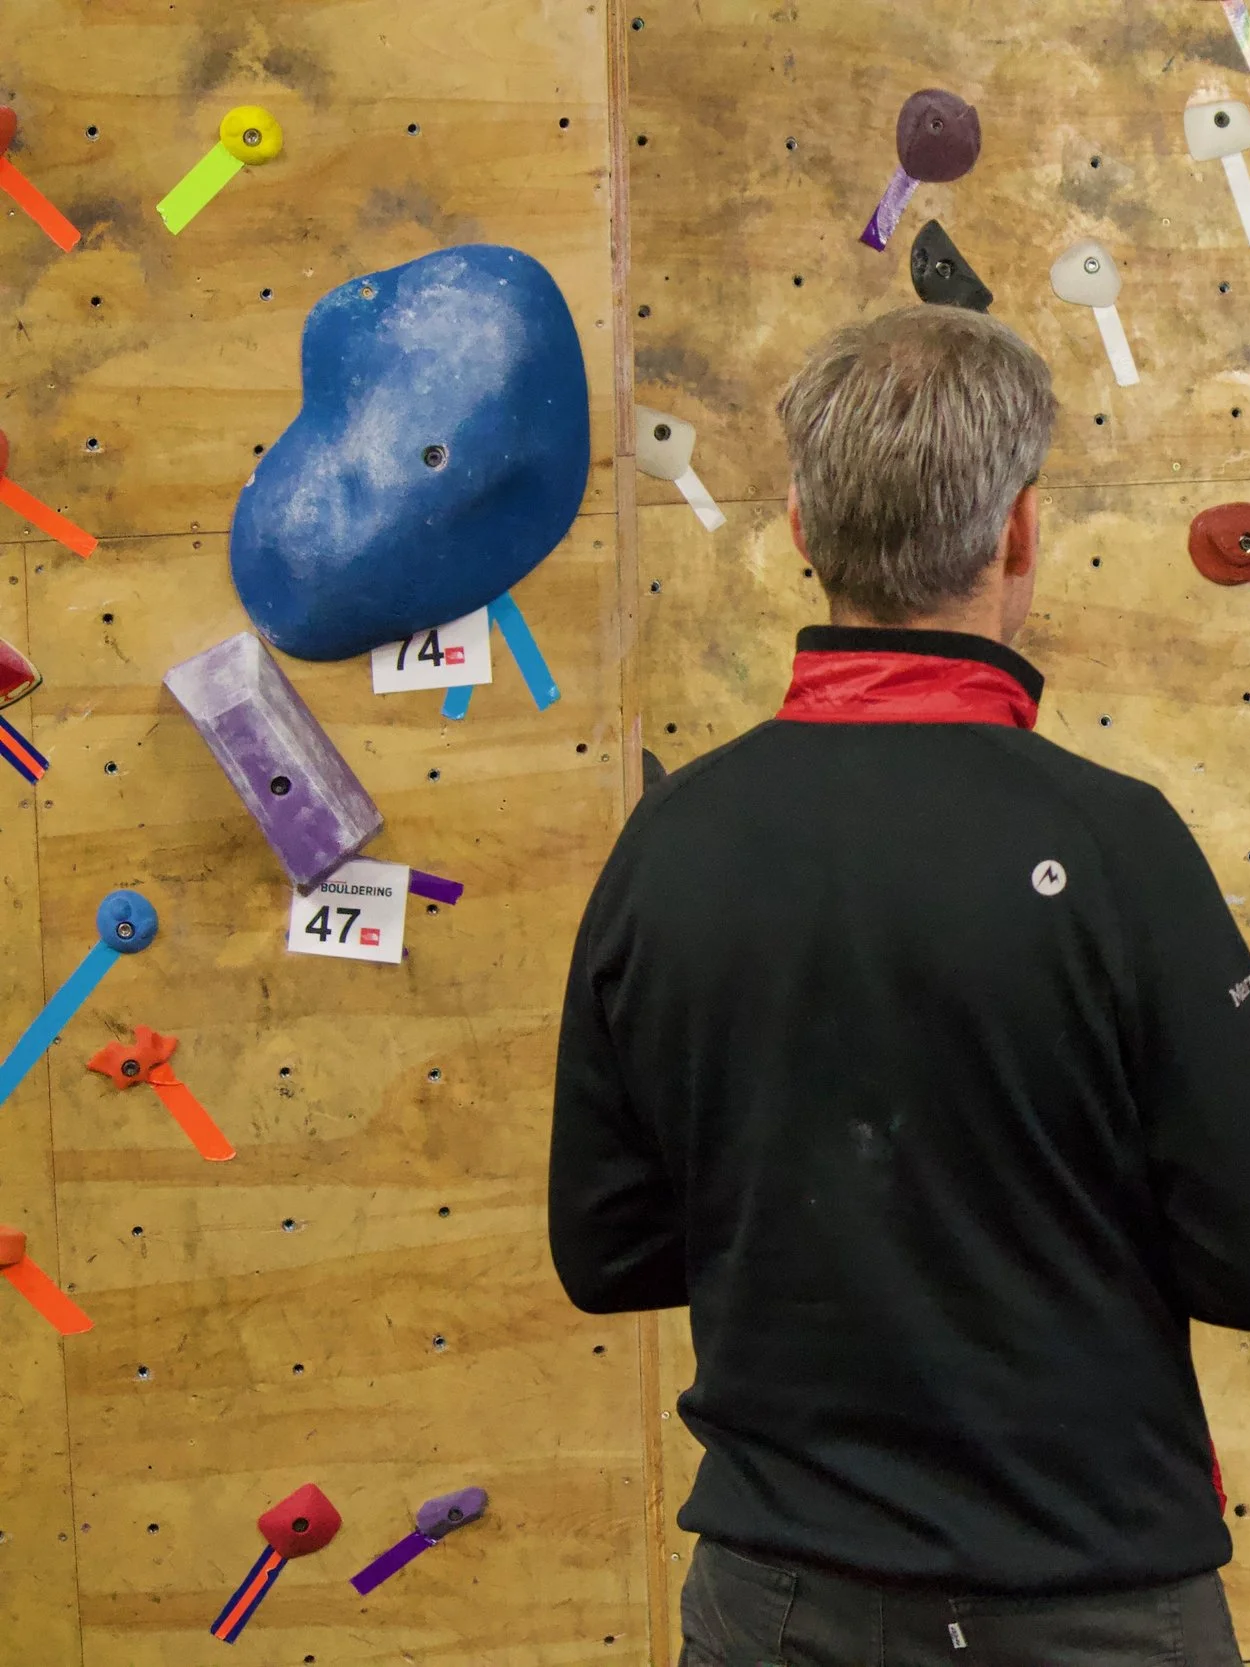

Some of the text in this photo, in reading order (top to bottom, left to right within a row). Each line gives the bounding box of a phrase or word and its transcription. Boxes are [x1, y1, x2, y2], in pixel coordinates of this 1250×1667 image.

[396, 629, 445, 671] 74
[320, 883, 393, 897] BOULDERING
[304, 905, 361, 944] 47
